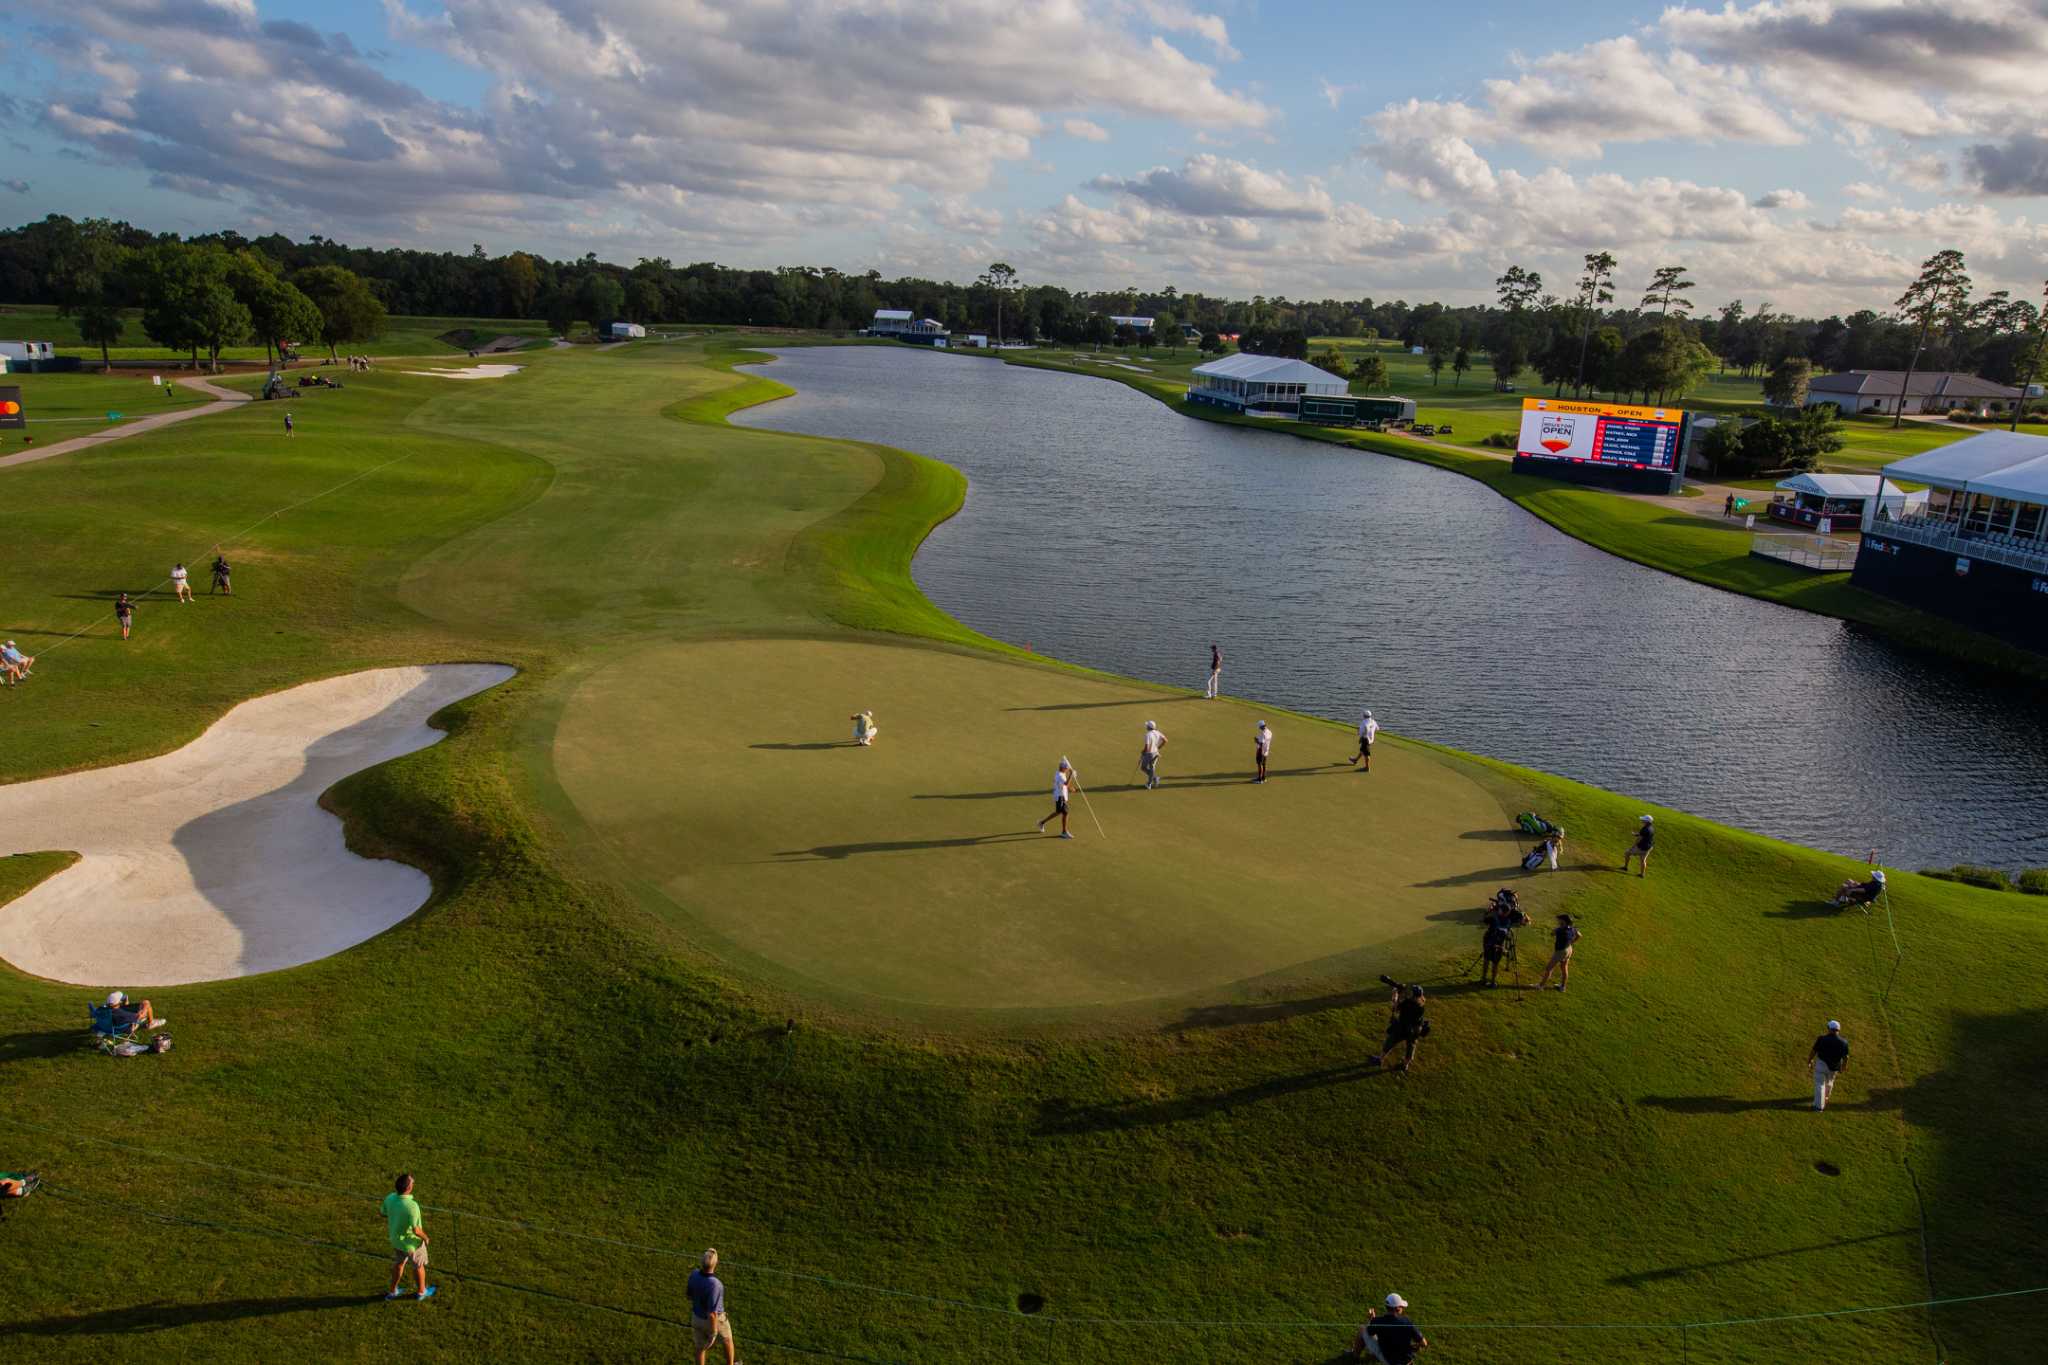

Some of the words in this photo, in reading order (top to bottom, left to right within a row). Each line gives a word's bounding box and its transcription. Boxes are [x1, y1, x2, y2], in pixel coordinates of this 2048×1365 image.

[1558, 404, 1601, 413] HOUSTON
[1617, 409, 1642, 417] OPEN
[1543, 427, 1571, 435] OPEN
